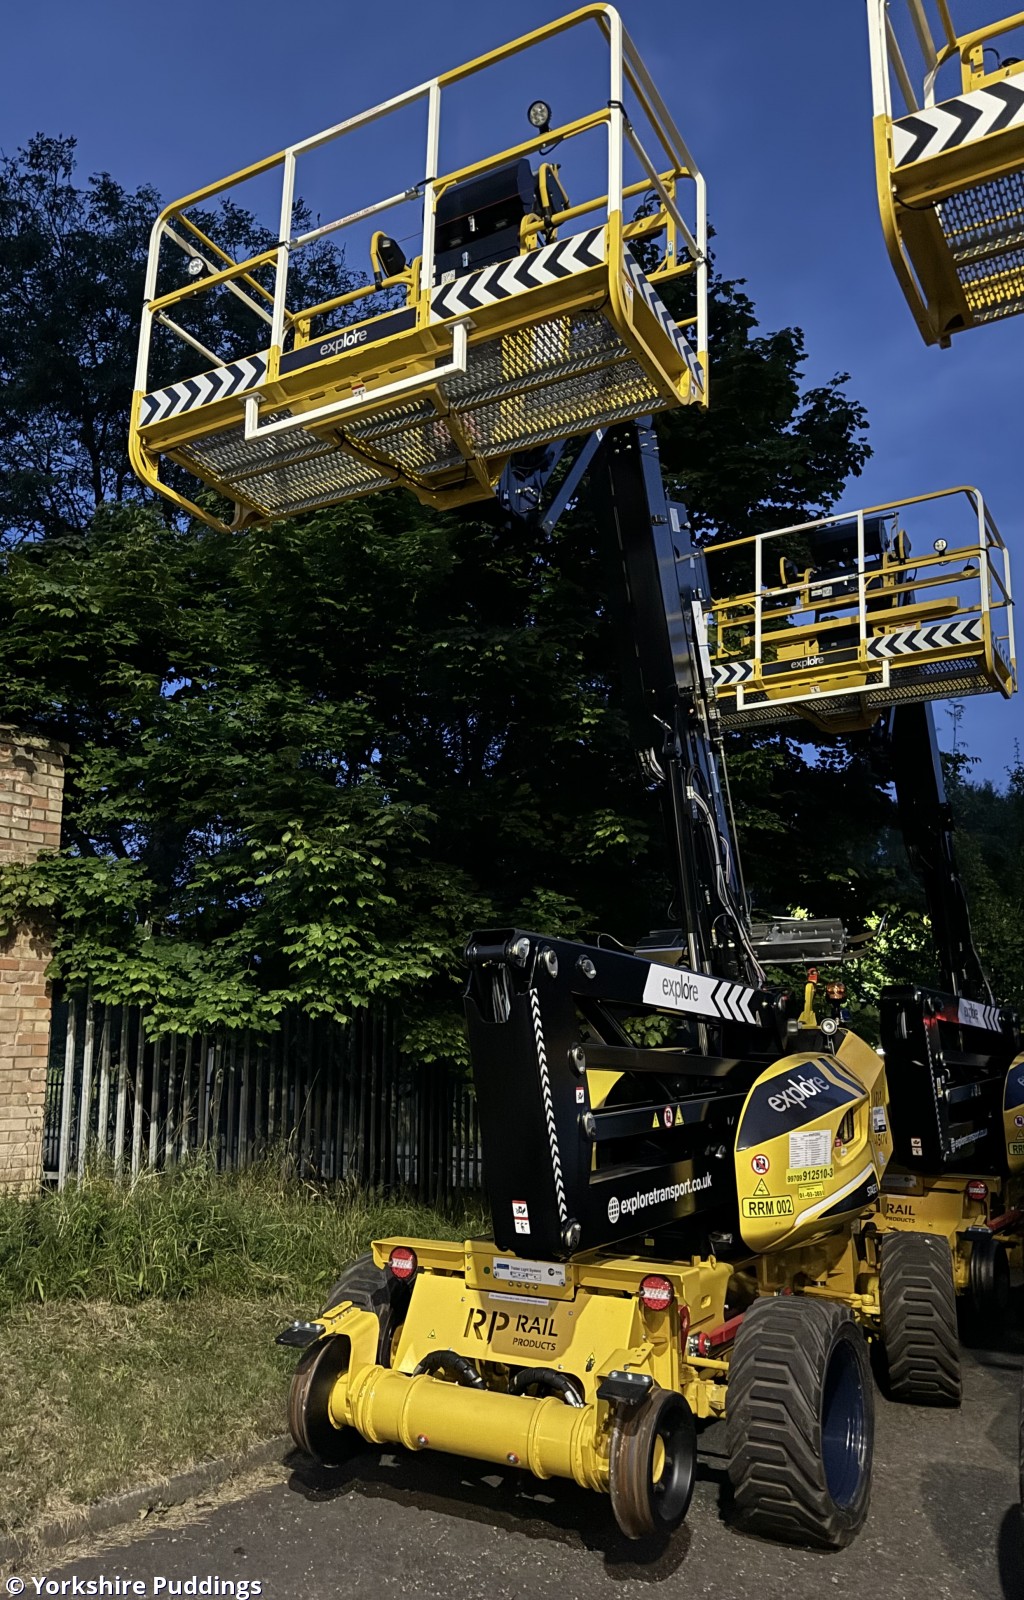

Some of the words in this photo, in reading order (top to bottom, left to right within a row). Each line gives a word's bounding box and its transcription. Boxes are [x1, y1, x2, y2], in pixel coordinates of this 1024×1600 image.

[320, 328, 367, 356] explore
[790, 655, 824, 669] explore
[662, 974, 699, 1005] explore
[767, 1074, 830, 1112] explore
[1012, 1144, 1024, 1154] RR
[620, 1171, 713, 1216] exploretransport.co.uk
[748, 1201, 775, 1216] RRM
[776, 1200, 793, 1214] 002
[885, 1203, 916, 1216] RAIL
[463, 1307, 510, 1345] RP
[515, 1314, 558, 1337] RAIL
[512, 1337, 557, 1351] PRODUCTS
